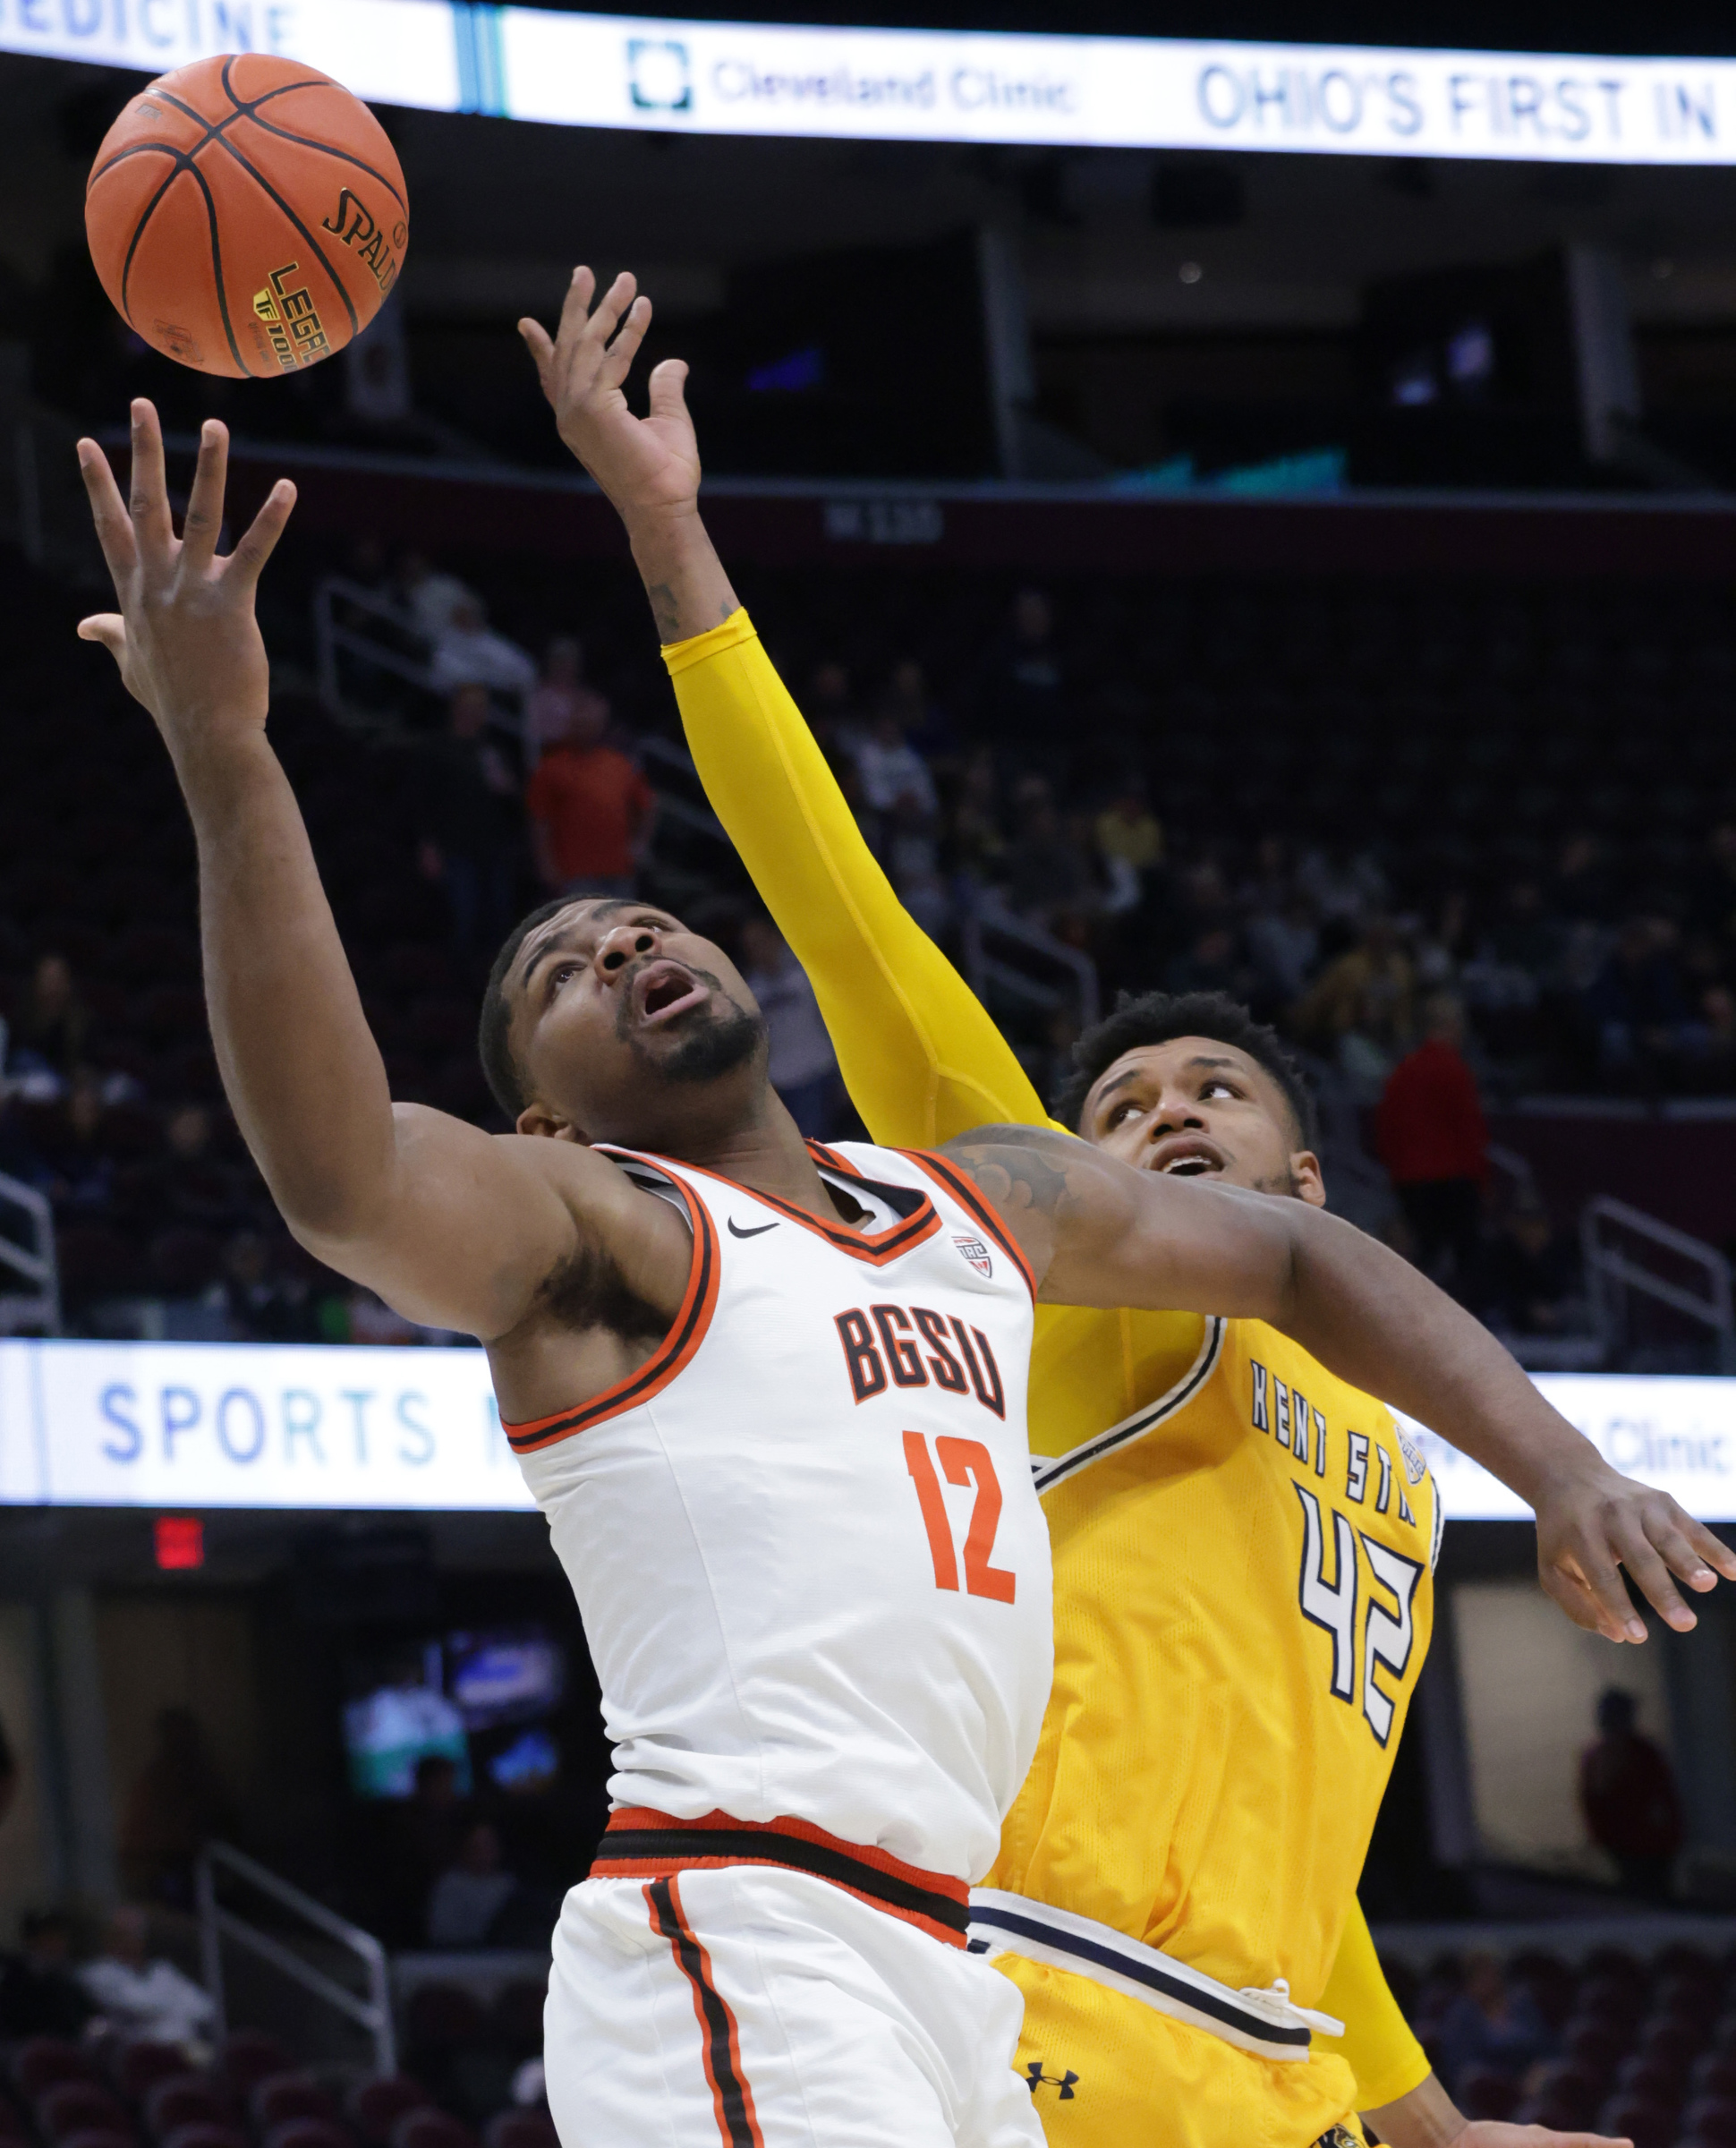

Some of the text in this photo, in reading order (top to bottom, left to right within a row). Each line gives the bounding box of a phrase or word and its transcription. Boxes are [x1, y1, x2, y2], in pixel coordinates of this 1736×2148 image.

[0, 0, 296, 55] EDICINE
[710, 57, 1082, 115] Cleveland Clinic
[1196, 63, 1718, 141] OHIO'S FIRST IN
[320, 186, 397, 303] SPALD
[833, 1304, 1006, 1421] BGSU
[1250, 1359, 1326, 1478] KENT
[97, 1380, 437, 1468] SPORTS
[902, 1430, 1016, 1605] 12
[1290, 1478, 1425, 1751] 42
